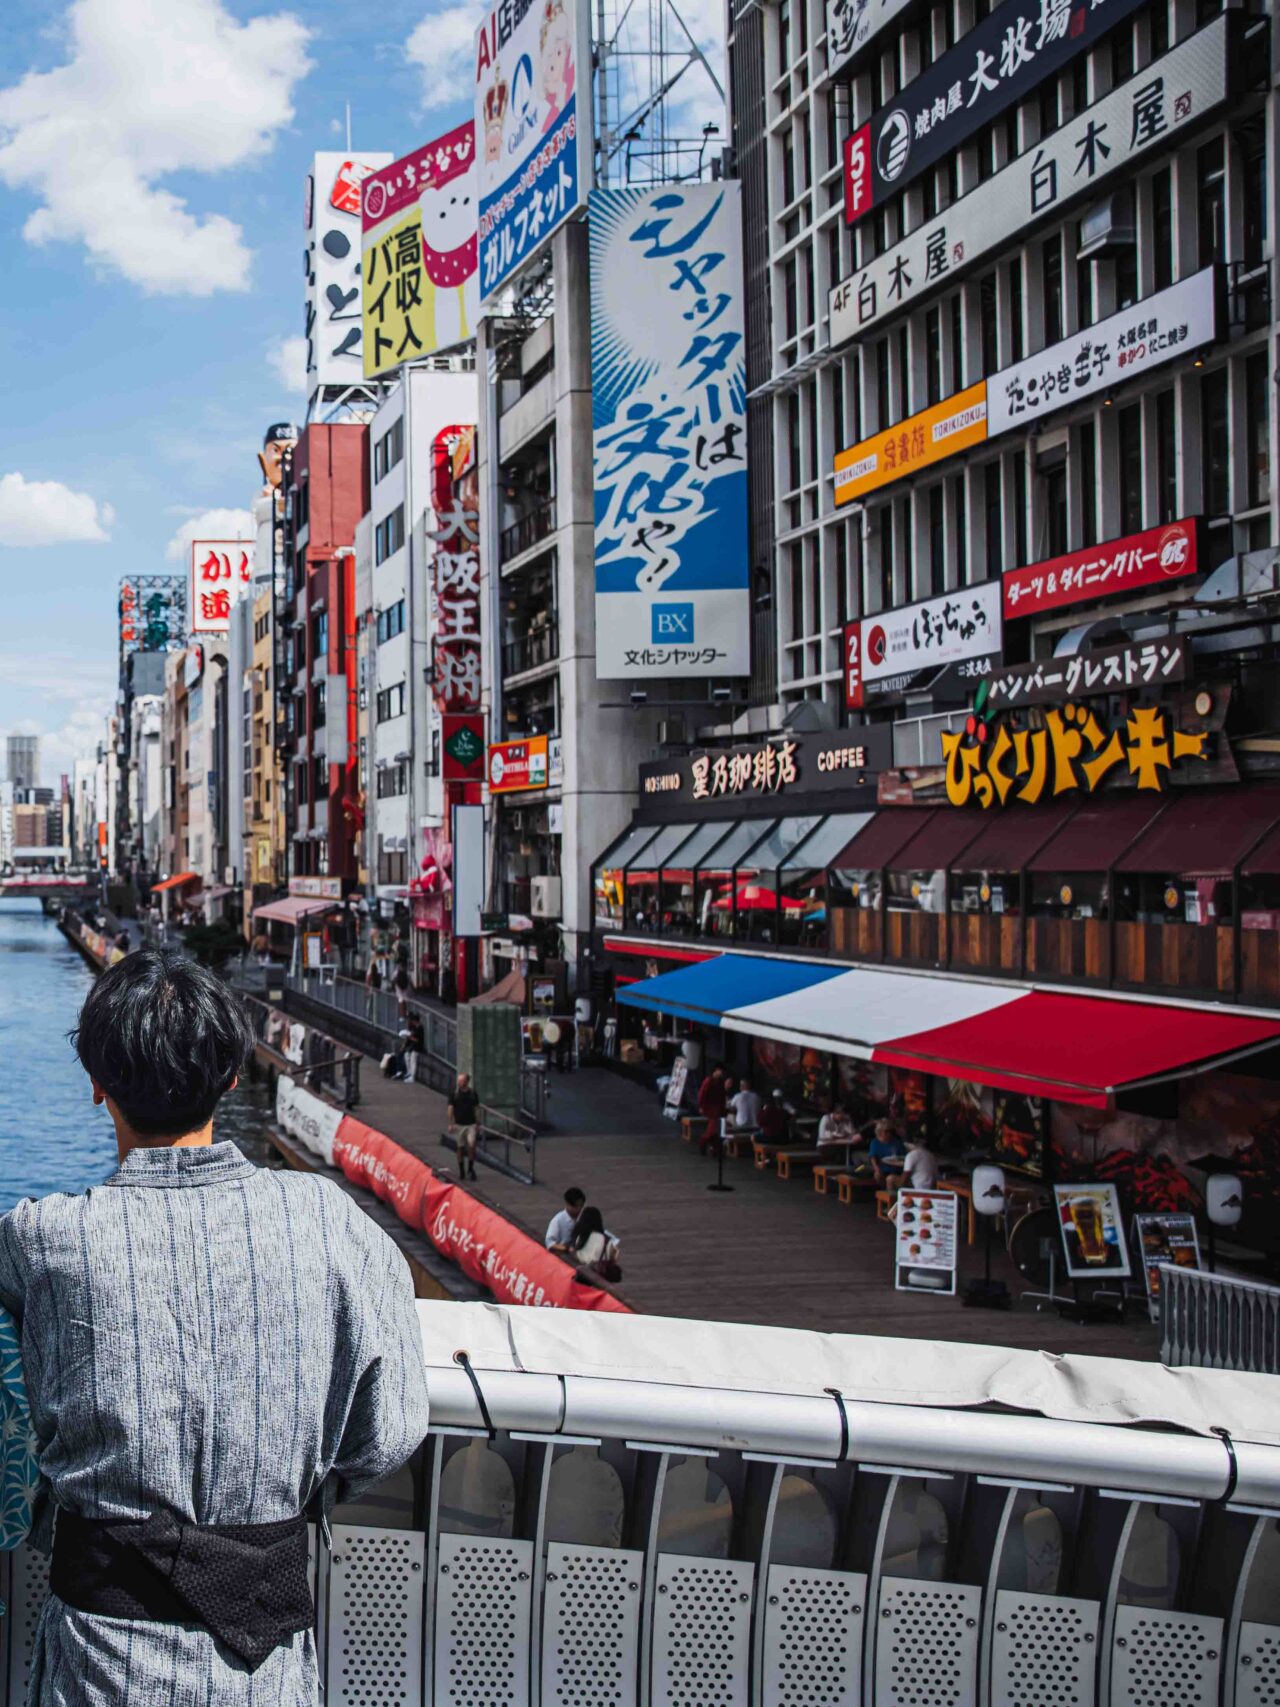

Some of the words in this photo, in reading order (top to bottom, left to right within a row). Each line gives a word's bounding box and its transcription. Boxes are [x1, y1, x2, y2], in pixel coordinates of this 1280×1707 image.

[914, 80, 963, 140] 焼肉屋
[385, 132, 473, 197] いちごなび
[1029, 76, 1169, 214] 白木屋
[484, 160, 573, 289] ガルフネット
[367, 236, 395, 368] バイト
[394, 222, 423, 359] 高収入
[833, 284, 852, 314] 4F
[858, 227, 948, 325] 白木屋
[1117, 318, 1158, 350] 大阪名物
[1117, 343, 1146, 368] 串かつ
[1007, 341, 1111, 416] たこやき王子
[934, 407, 981, 438] TORIKIZOKU
[835, 461, 872, 486] TORIKIZOKU
[1046, 573, 1057, 593] &
[1060, 548, 1158, 591] ダイニングバー
[427, 500, 481, 702] 大阪王将
[658, 613, 688, 633] BX
[989, 645, 1182, 700] ハンバーグレストラン
[644, 772, 680, 793] HOSHINO
[691, 740, 798, 800] 星乃珈琲店
[817, 746, 865, 771] COFFEE
[940, 702, 1208, 808] びっくりドンキー
